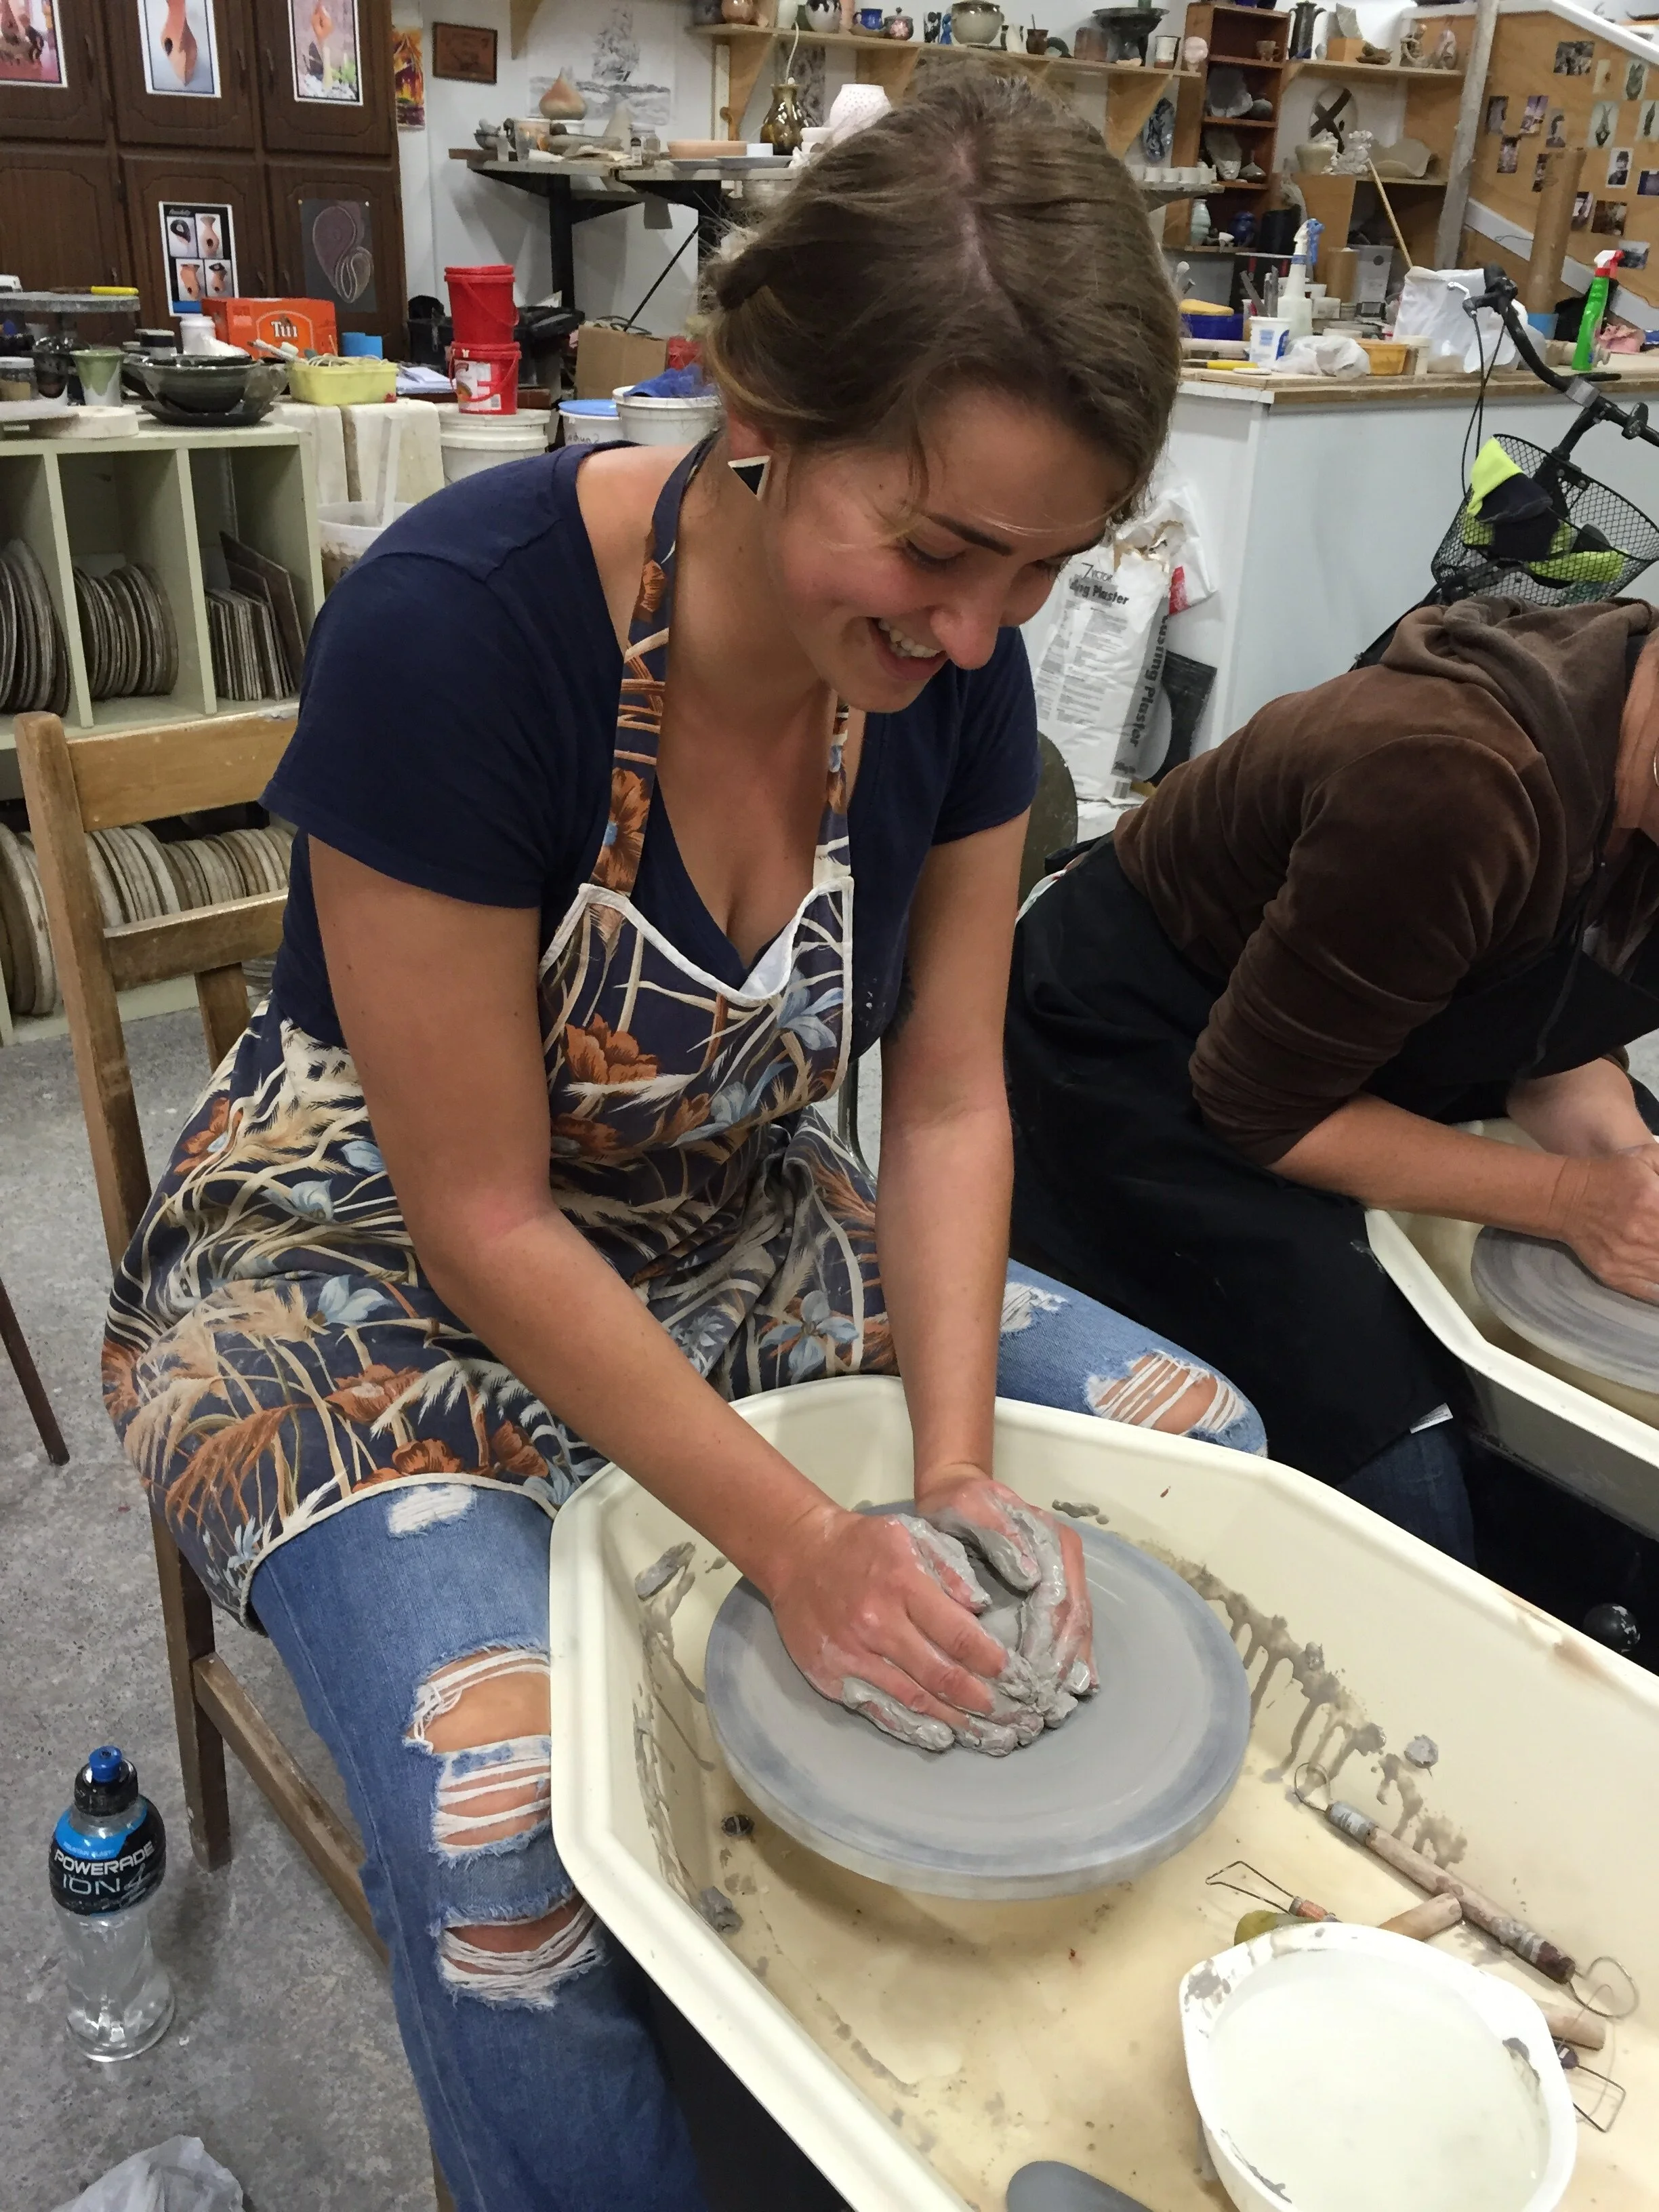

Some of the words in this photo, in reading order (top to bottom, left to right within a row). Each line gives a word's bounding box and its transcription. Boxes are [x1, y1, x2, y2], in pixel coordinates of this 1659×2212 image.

[271, 321, 298, 338] Tui
[1092, 585, 1130, 605] Plaster
[1129, 685, 1157, 747] Plaster
[54, 1840, 156, 1877] POWERADE
